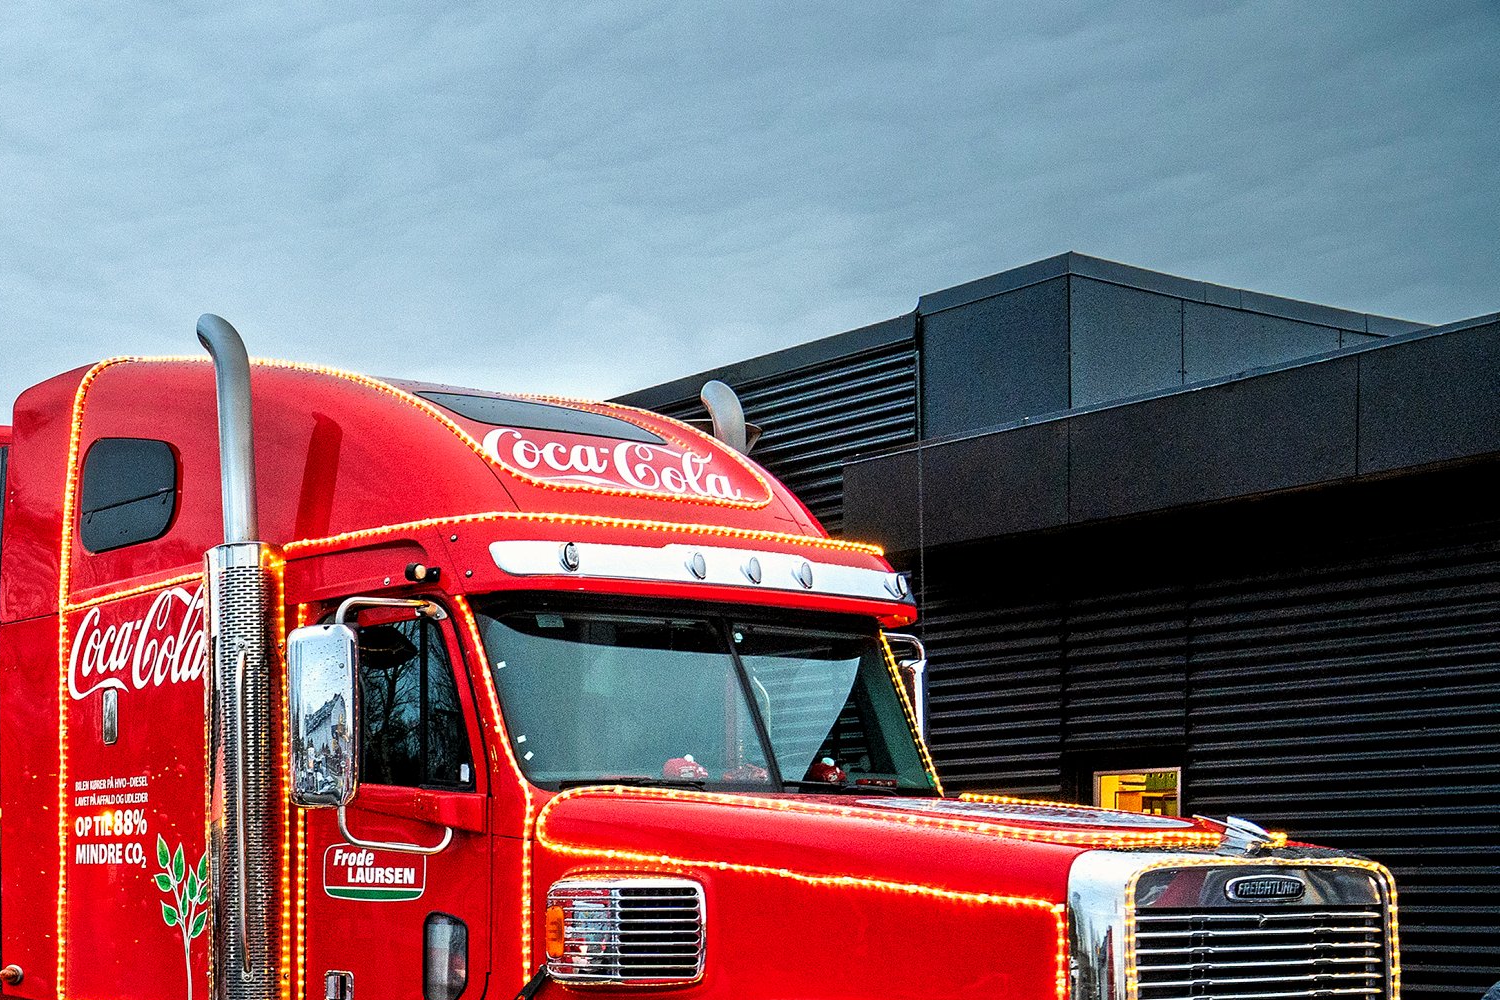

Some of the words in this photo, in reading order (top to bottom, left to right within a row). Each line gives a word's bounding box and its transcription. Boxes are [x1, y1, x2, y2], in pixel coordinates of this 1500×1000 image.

[482, 427, 742, 500] Coca-Cola
[68, 586, 204, 700] Coca-Cola
[75, 780, 89, 791] BILEN
[90, 778, 106, 790] KØRER
[107, 776, 115, 789] PÅ
[75, 796, 90, 807] LAVET
[90, 793, 97, 805] PÅ
[97, 794, 115, 806] AFFALD
[116, 794, 124, 804] OG
[125, 792, 148, 804] UDLEDER
[75, 816, 92, 837] OP
[93, 814, 112, 836] TIL
[113, 808, 148, 836] 88%
[75, 843, 123, 864] MINDRE
[333, 848, 374, 866] Frode
[347, 867, 415, 884] LAURSEN
[1237, 881, 1300, 895] FREIGHTLINER
